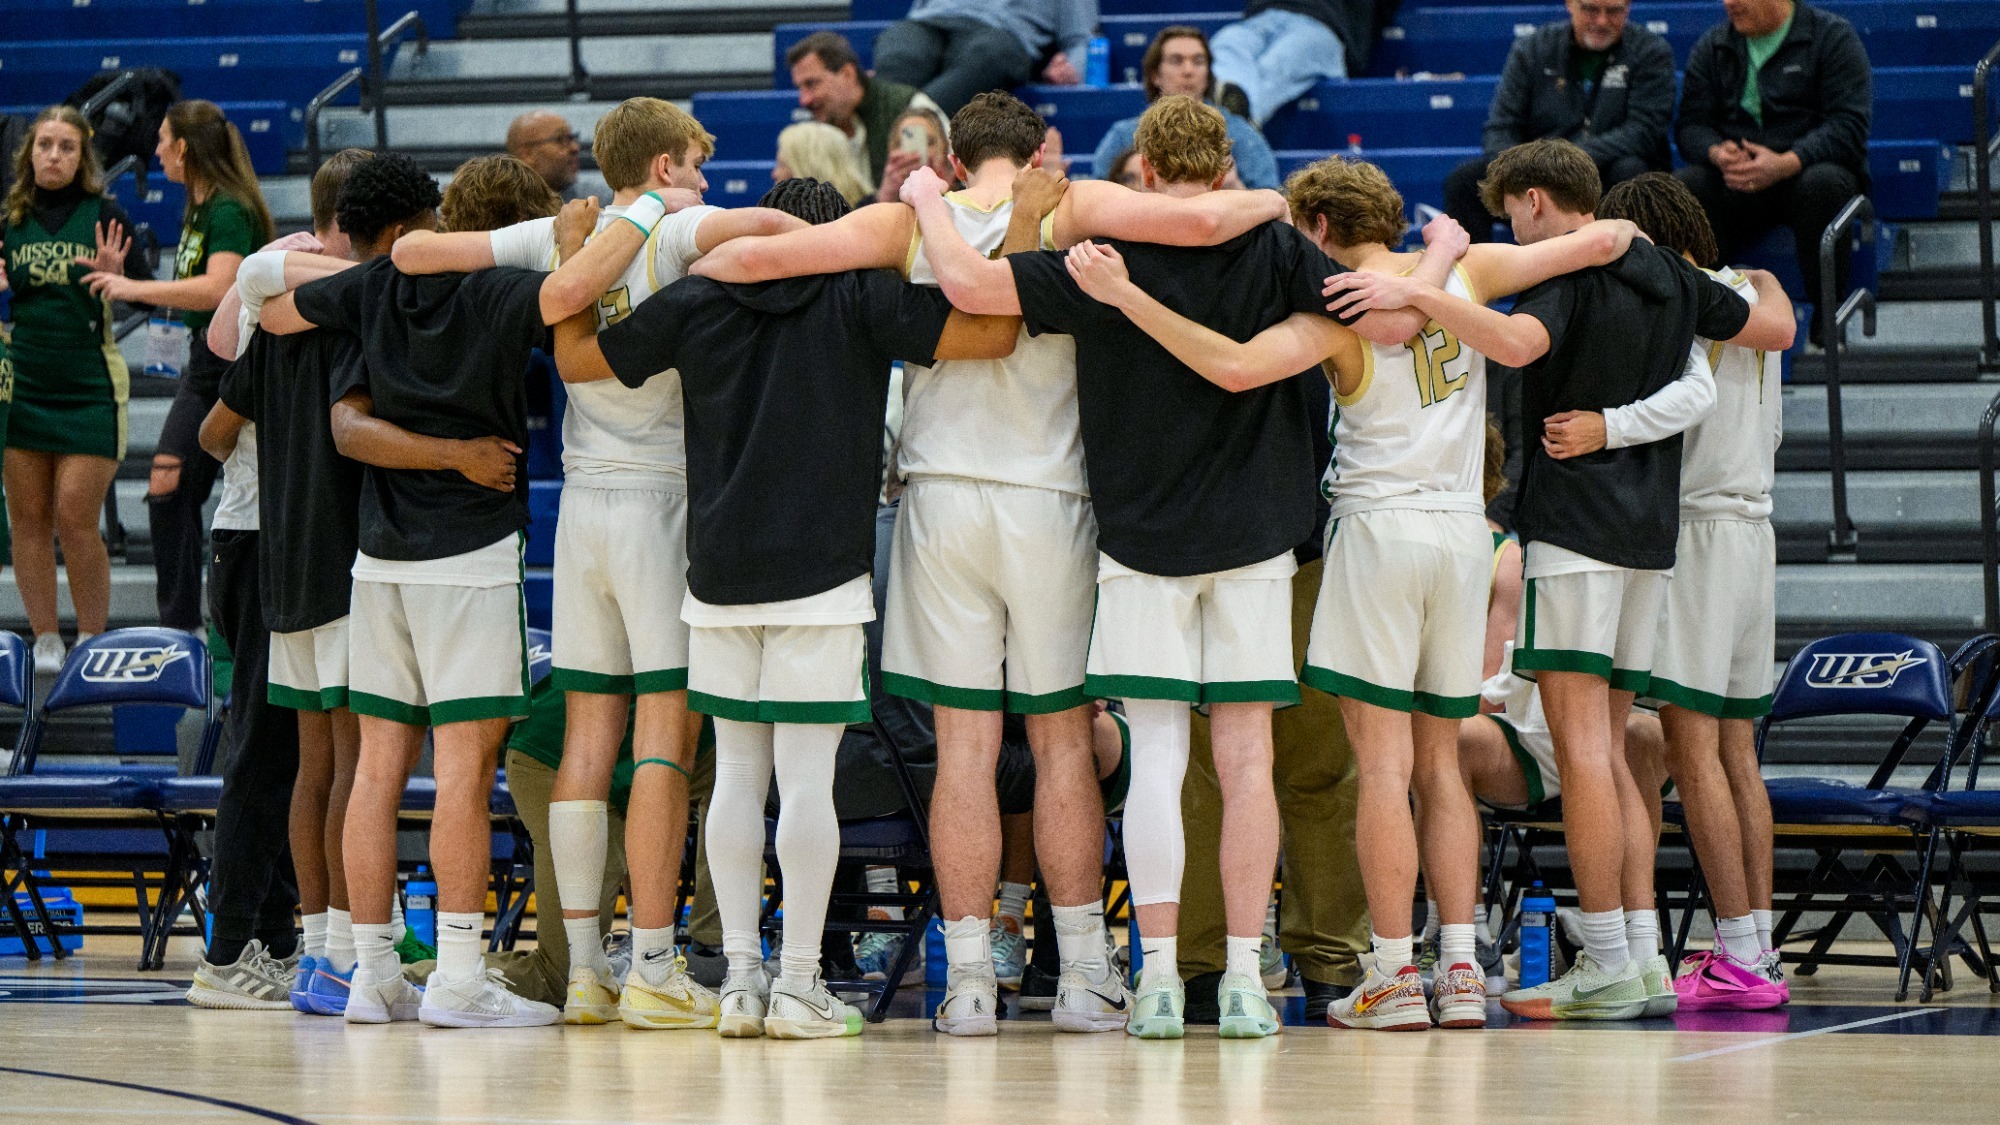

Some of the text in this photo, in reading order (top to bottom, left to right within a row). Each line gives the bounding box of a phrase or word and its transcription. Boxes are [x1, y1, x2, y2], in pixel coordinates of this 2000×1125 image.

[1404, 318, 1469, 409] 12
[81, 647, 165, 682] UIS
[1806, 653, 1902, 688] UIS
